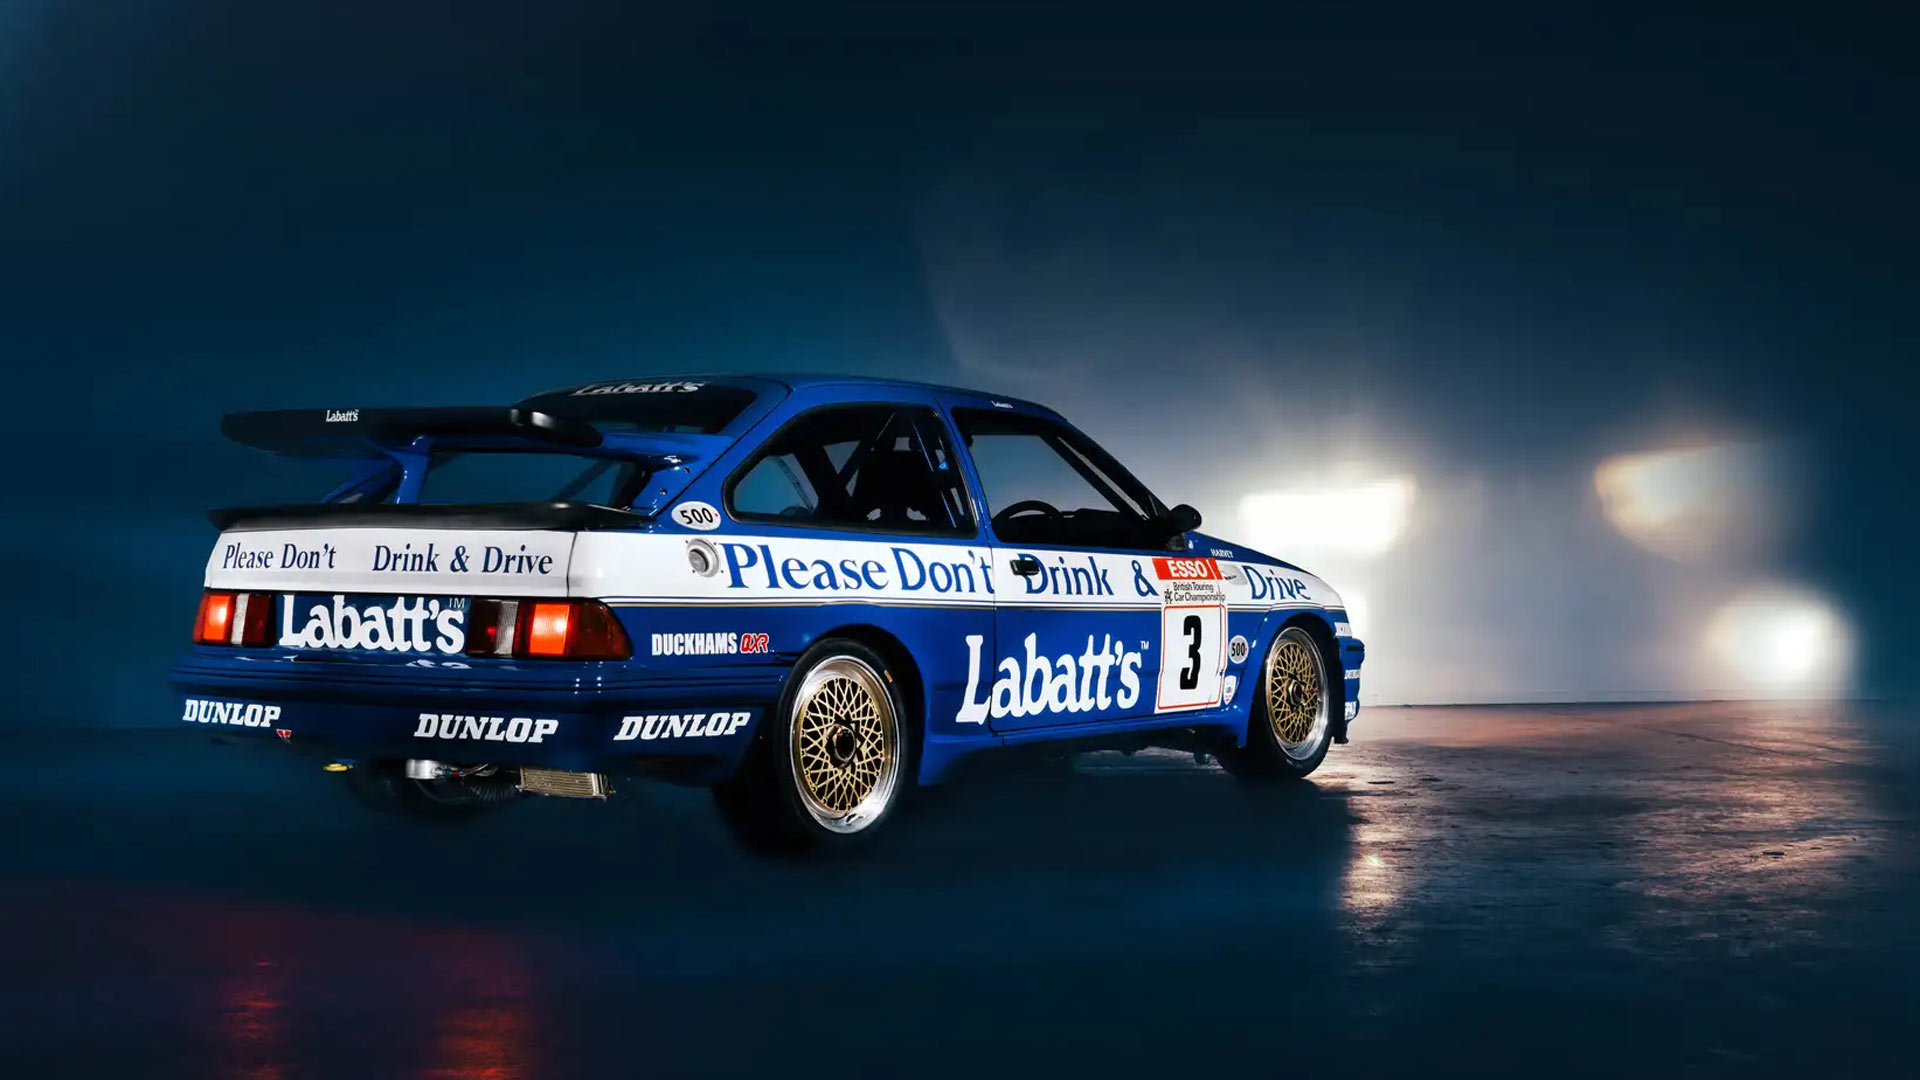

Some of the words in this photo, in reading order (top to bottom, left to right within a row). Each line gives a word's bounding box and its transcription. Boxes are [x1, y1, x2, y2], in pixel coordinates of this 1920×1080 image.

[325, 408, 359, 423] Labatt's
[679, 507, 714, 525] 500
[222, 544, 274, 570] Please
[281, 543, 337, 569] Don't
[373, 544, 439, 573] Drink
[450, 546, 470, 574] &
[482, 546, 553, 575] Drive
[1210, 548, 1234, 558] HARVEY
[718, 542, 890, 591] Please
[891, 547, 995, 595] Don't
[1017, 553, 1114, 596] Drink
[1131, 560, 1158, 597] &
[1243, 564, 1310, 601] Drive
[1166, 559, 1208, 578] ESSO
[1173, 581, 1192, 591] British
[1192, 581, 1214, 593] Touring
[1173, 592, 1185, 601] Car
[1185, 591, 1226, 604] Championship
[280, 594, 466, 654] Labatt's
[651, 632, 738, 656] DUCKHAMS
[739, 632, 769, 654] QXR
[1179, 614, 1202, 690] 3
[1231, 642, 1246, 657] 500
[955, 632, 1143, 725] Labatt's
[182, 698, 281, 728] DUNLOP
[613, 711, 752, 742] DUNLOP
[414, 712, 559, 744] DUNLOP
